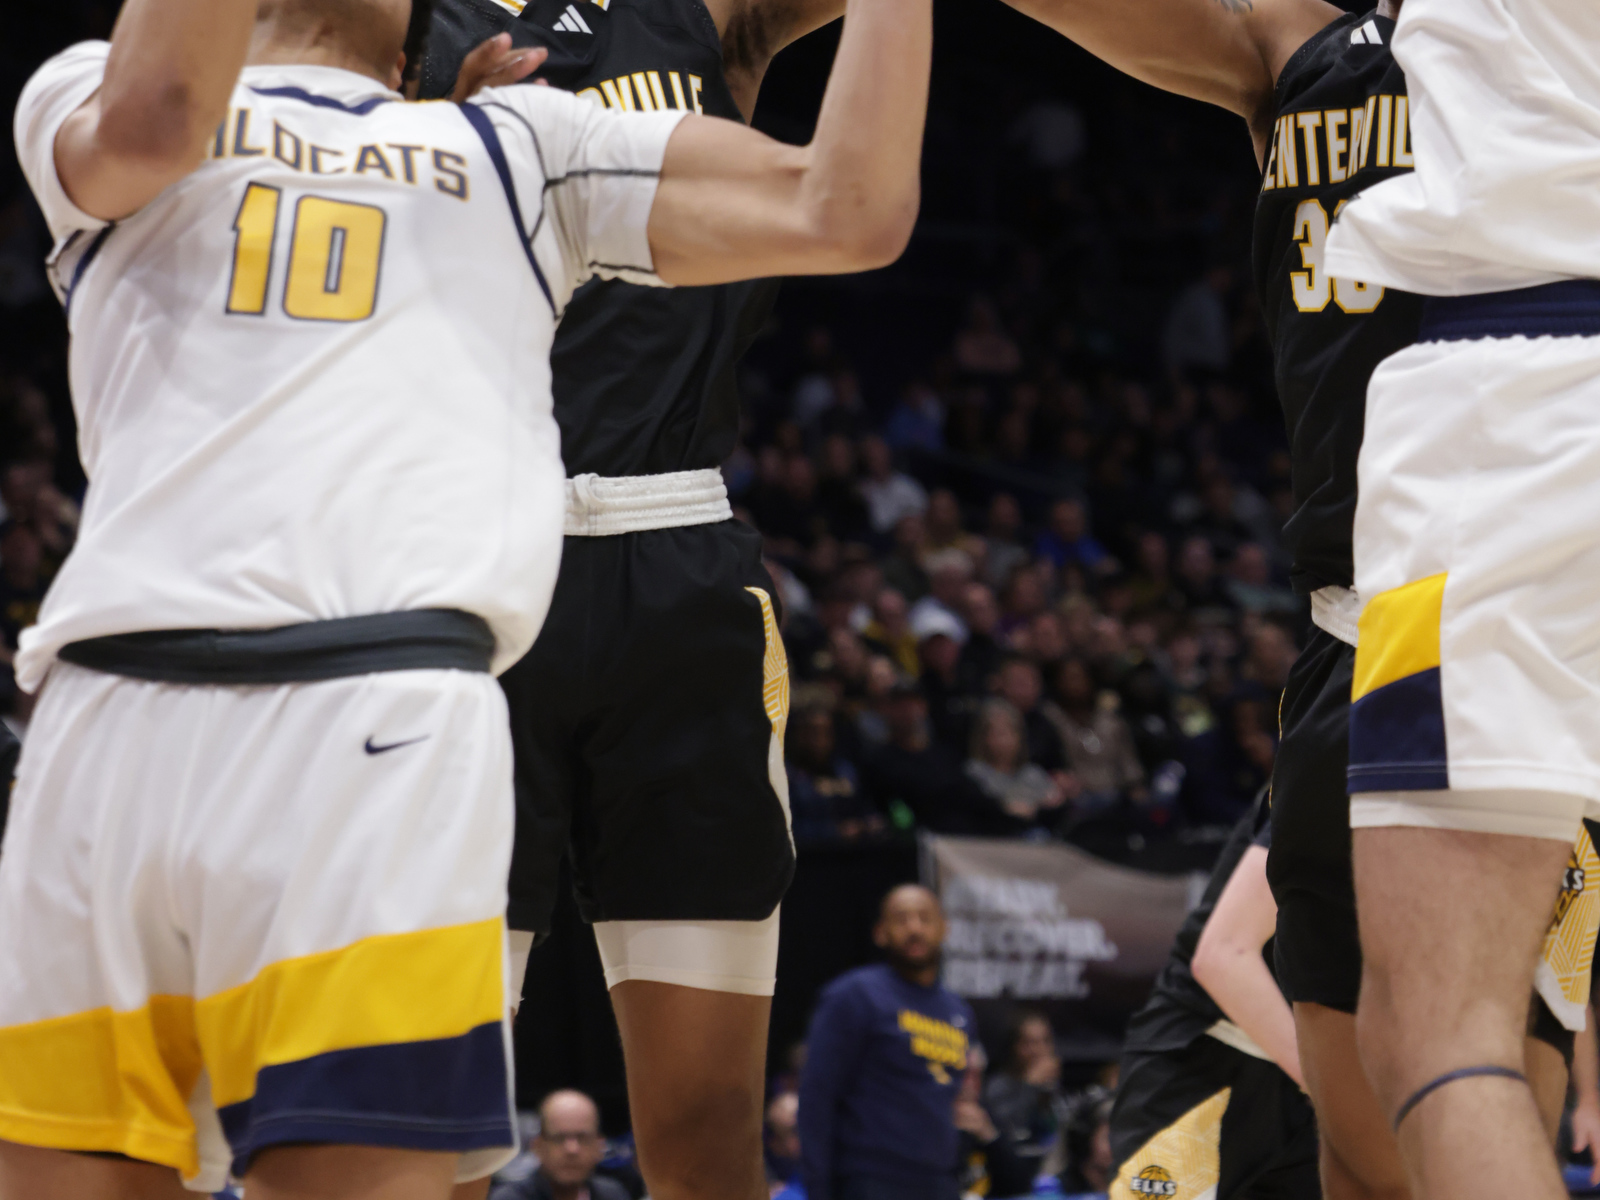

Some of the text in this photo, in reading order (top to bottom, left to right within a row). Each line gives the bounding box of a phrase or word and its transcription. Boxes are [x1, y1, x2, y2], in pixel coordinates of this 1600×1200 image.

[206, 107, 470, 202] ILDCATS
[225, 180, 388, 323] 10
[1130, 1177, 1177, 1196] ELKS
